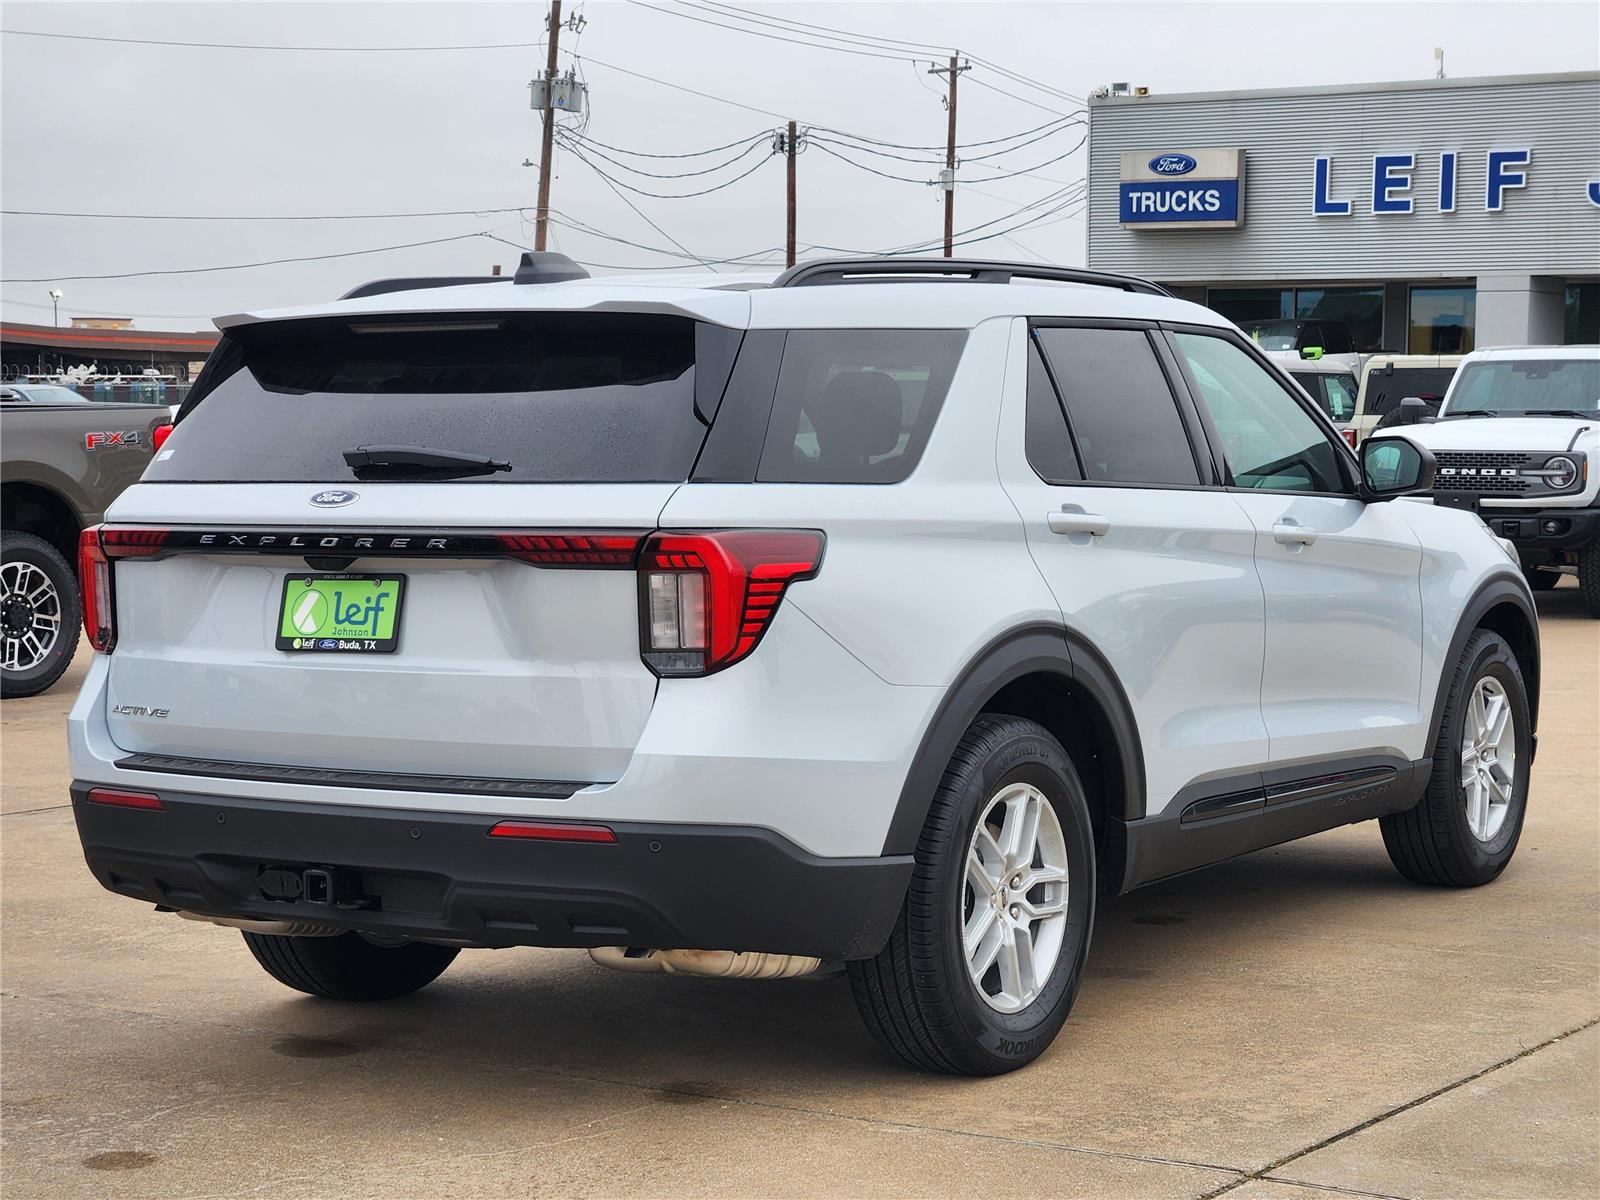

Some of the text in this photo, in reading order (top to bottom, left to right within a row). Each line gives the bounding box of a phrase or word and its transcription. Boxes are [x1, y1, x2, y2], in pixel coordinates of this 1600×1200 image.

[1312, 149, 1531, 217] LEIF
[1129, 190, 1220, 213] TRUCKS
[85, 430, 143, 451] FX4
[1434, 467, 1517, 476] ONCO
[199, 534, 448, 549] EXPLORER
[332, 627, 369, 637] Johnson
[338, 640, 361, 650] Buda,
[364, 640, 377, 650] TX
[113, 703, 170, 718] ACTIVE
